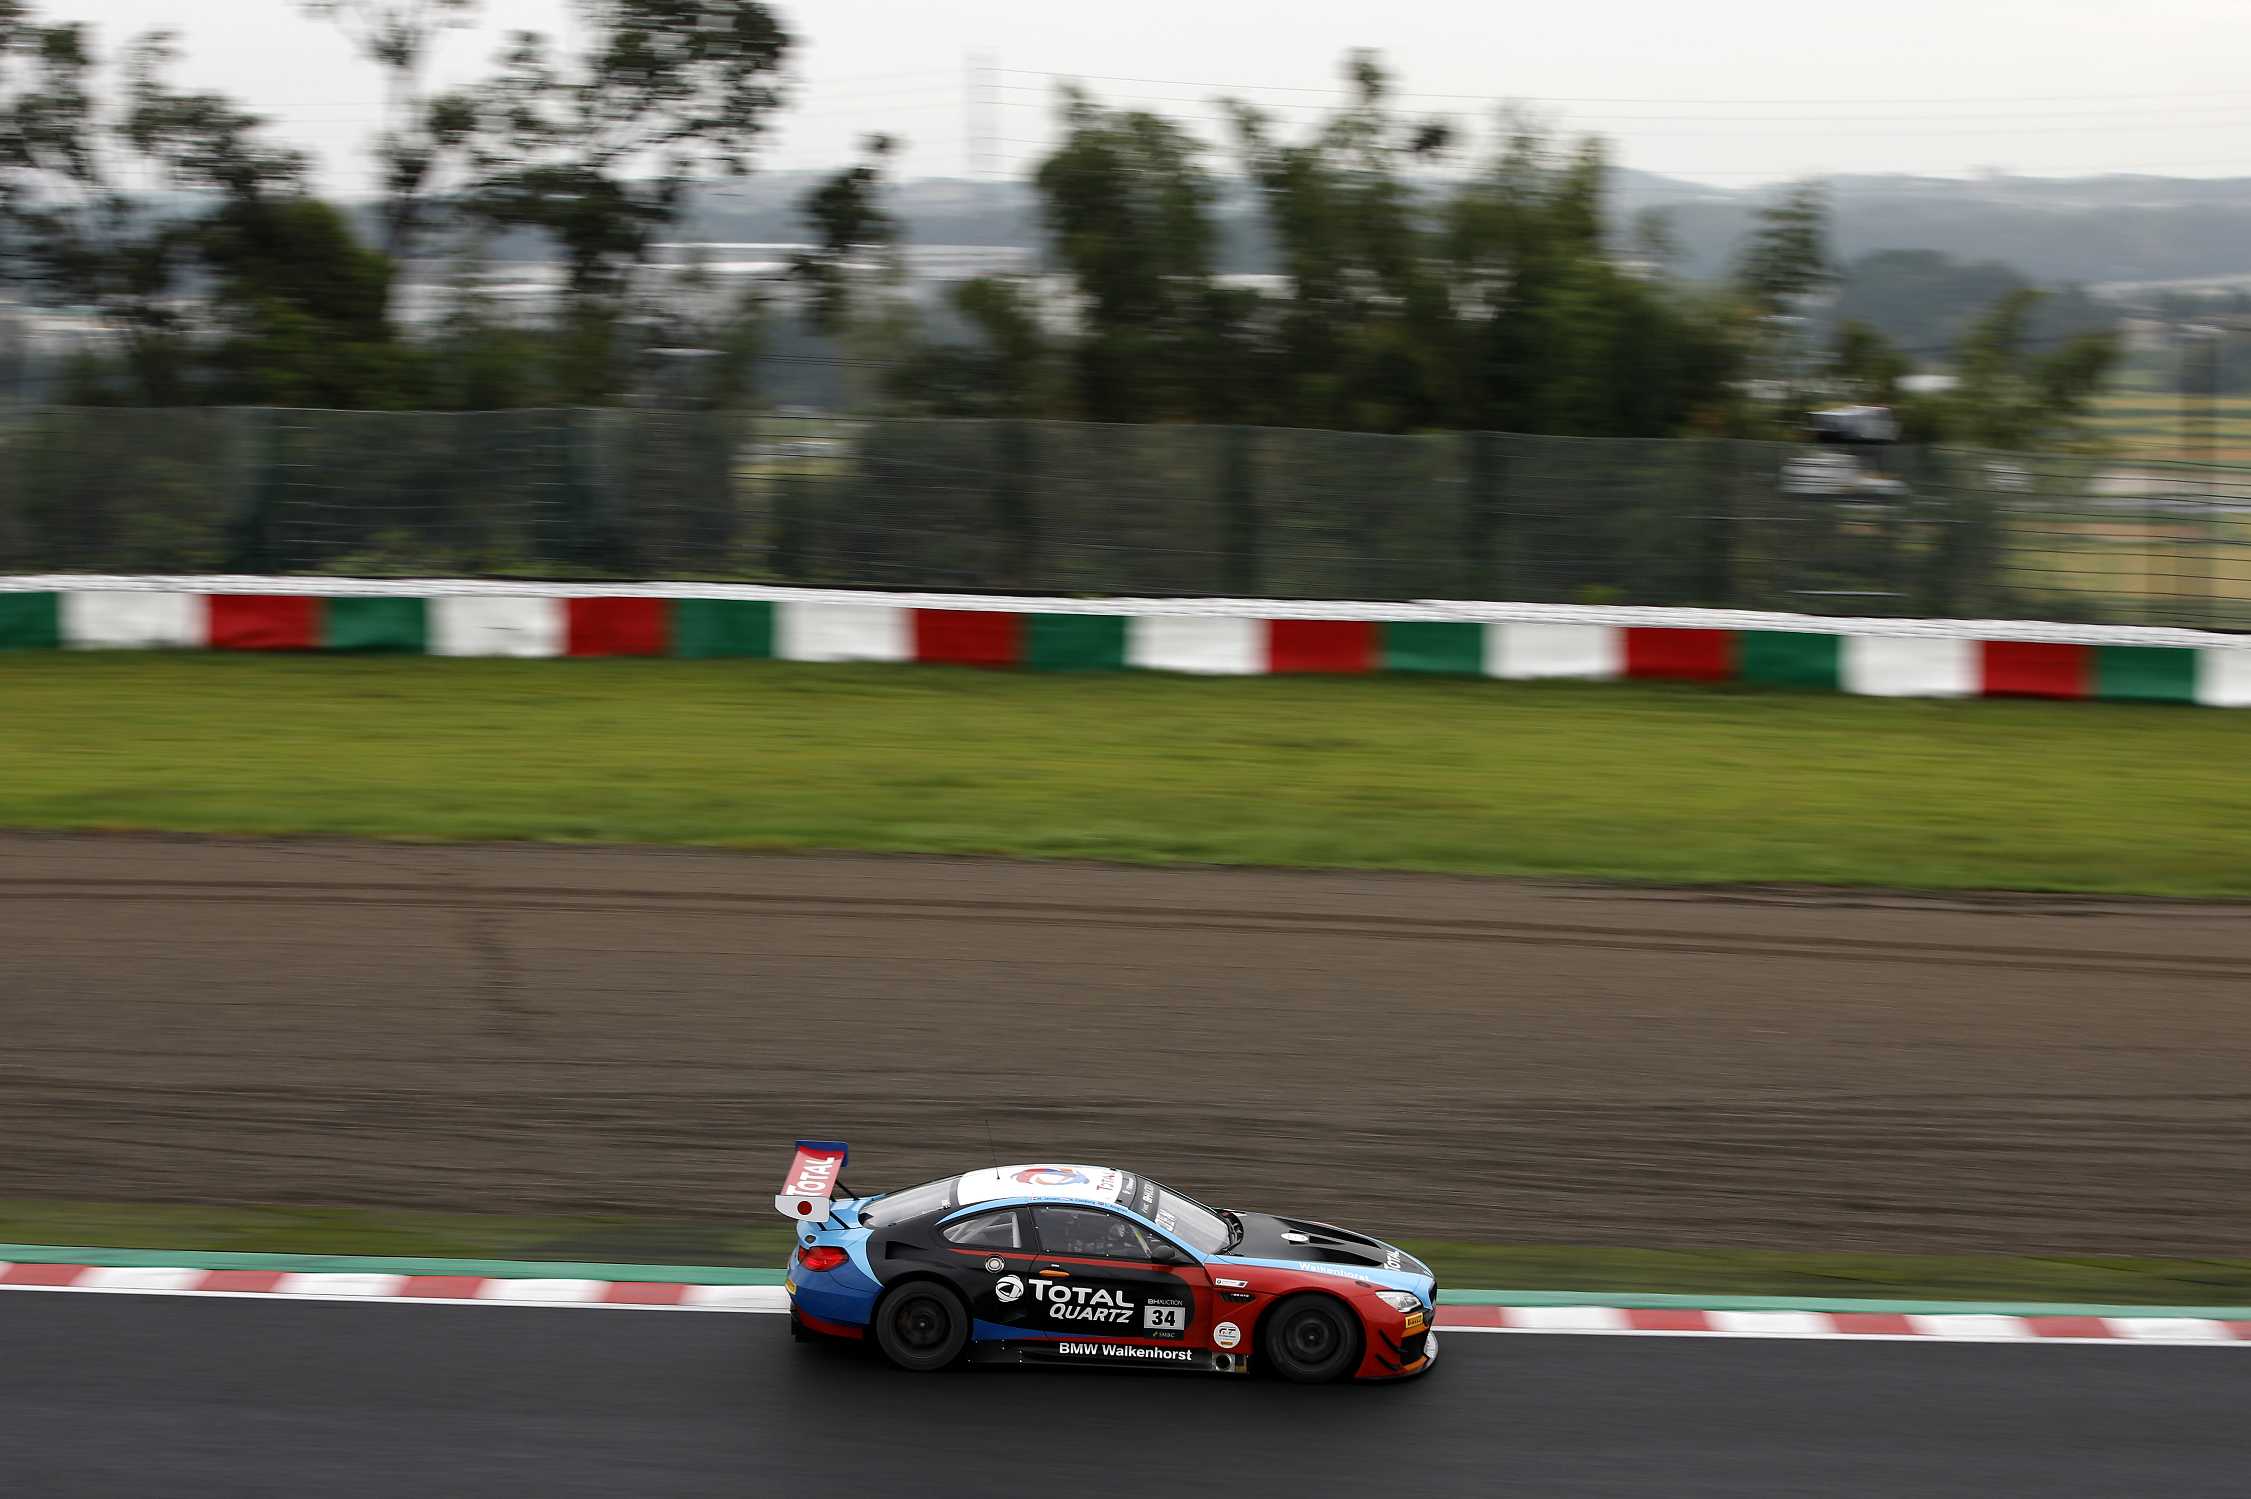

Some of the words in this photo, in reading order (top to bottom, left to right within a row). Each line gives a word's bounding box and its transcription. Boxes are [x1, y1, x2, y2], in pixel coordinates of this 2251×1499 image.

[786, 1157, 835, 1196] TOTAL
[1029, 1279, 1134, 1308] TOTAL
[1049, 1303, 1134, 1323] QUARTZ
[1151, 1309, 1176, 1327] 34
[1059, 1342, 1098, 1355] BMW
[1102, 1344, 1193, 1361] Walkenhorst
